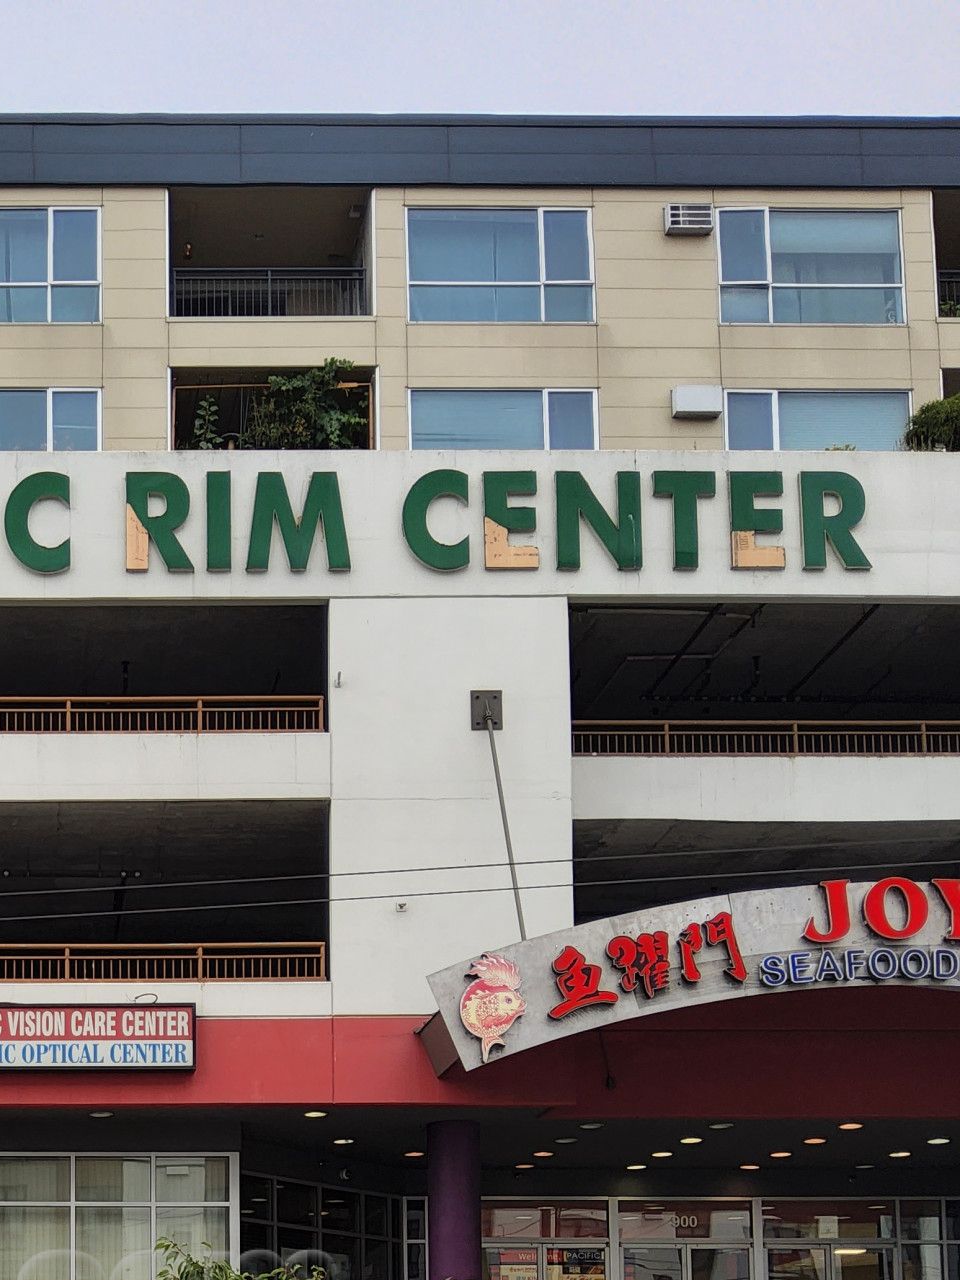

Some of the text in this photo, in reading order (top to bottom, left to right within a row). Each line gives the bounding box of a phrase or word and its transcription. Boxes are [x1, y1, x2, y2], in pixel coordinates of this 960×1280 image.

[127, 473, 349, 573] RIM
[402, 471, 871, 573] CENTER
[760, 946, 959, 986] SEAFOOD
[8, 1010, 65, 1036] VISION
[71, 1010, 117, 1036] CARE
[123, 1010, 189, 1036] CENTER
[21, 1043, 104, 1064] OPTICAL
[110, 1043, 188, 1064] CENTER
[672, 1215, 698, 1228] 900
[566, 1252, 601, 1260] PACIFIC
